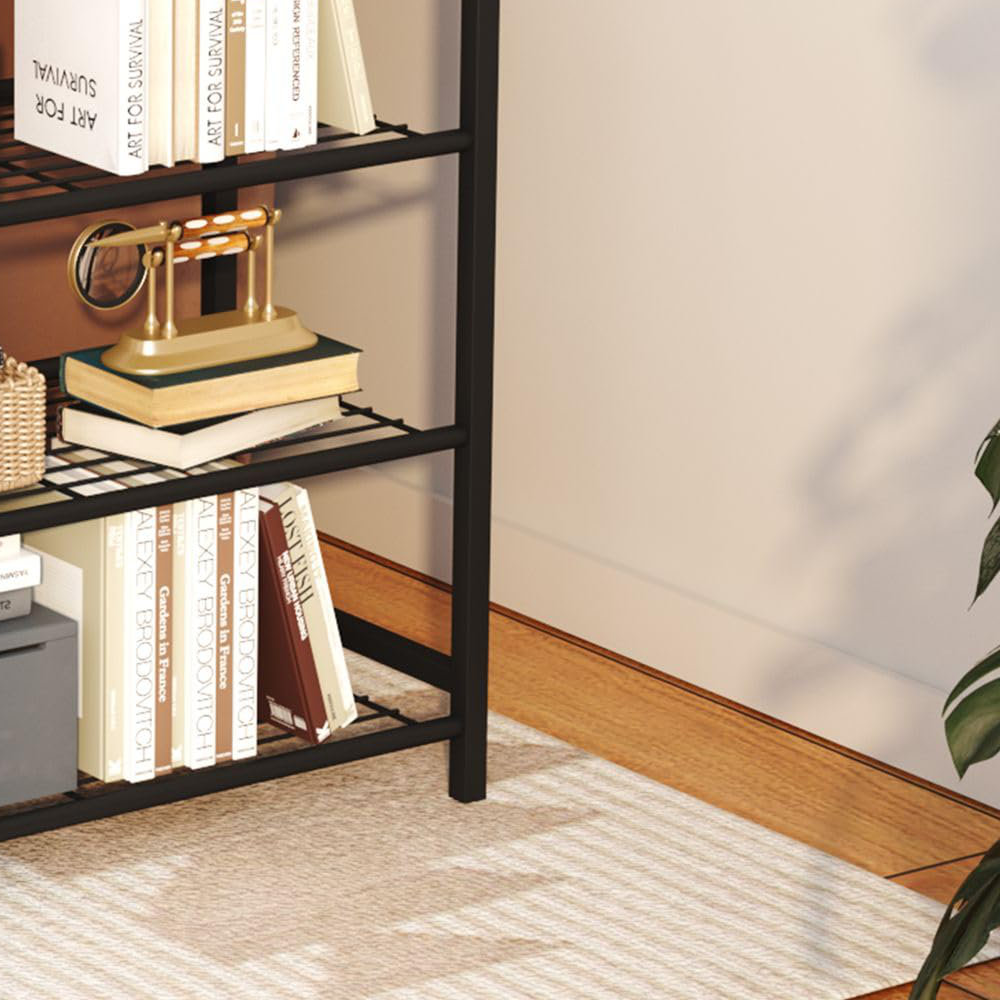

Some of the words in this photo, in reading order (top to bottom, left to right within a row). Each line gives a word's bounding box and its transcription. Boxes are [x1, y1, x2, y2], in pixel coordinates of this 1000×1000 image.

[128, 19, 143, 88] SURVIVAL
[208, 8, 223, 77] SURVIVAL
[292, 26, 301, 102] REFERENCED
[32, 59, 96, 98] SURVIVAL
[207, 82, 222, 113] FOR
[35, 93, 64, 121] FOR
[70, 106, 97, 131] ART
[127, 93, 143, 125] FOR
[207, 120, 222, 146] ART
[127, 132, 143, 159] ART
[136, 510, 154, 600] ALEXEY
[197, 498, 215, 588] ALEXEY
[239, 491, 257, 580] ALEXEY
[159, 585, 170, 640] Gardens
[219, 573, 230, 628] Gardens
[159, 641, 170, 656] in
[219, 629, 230, 643] in
[135, 608, 154, 764] BRODOVITCH
[196, 596, 215, 751] BRODOVITCH
[238, 588, 256, 741] BRODOVITCH
